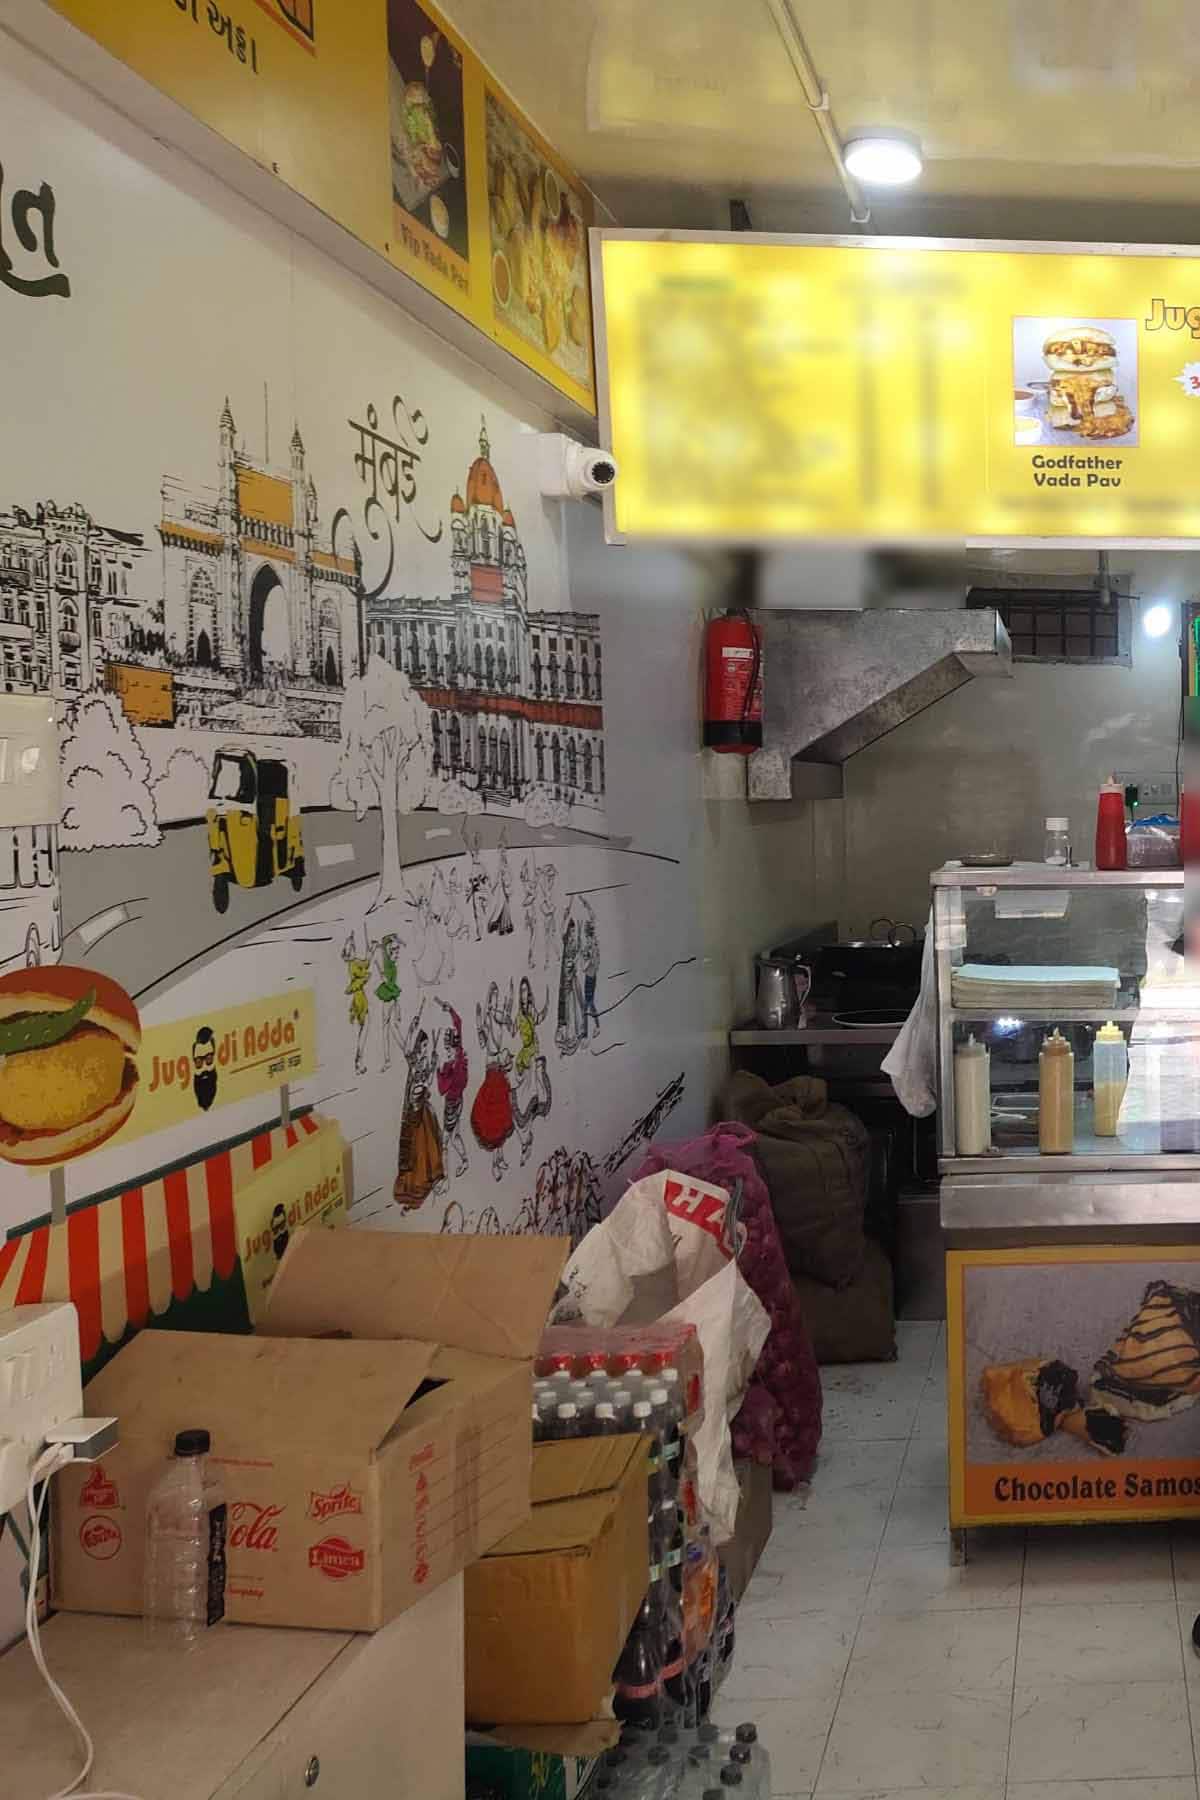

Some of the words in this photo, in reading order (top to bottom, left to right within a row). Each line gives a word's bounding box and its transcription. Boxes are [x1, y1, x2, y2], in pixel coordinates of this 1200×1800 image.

[1031, 455, 1123, 471] Godfather
[1033, 473, 1081, 487] Vada
[1087, 473, 1122, 487] Pav
[244, 1018, 295, 1058] Adda
[994, 1475, 1116, 1501] Chocolate
